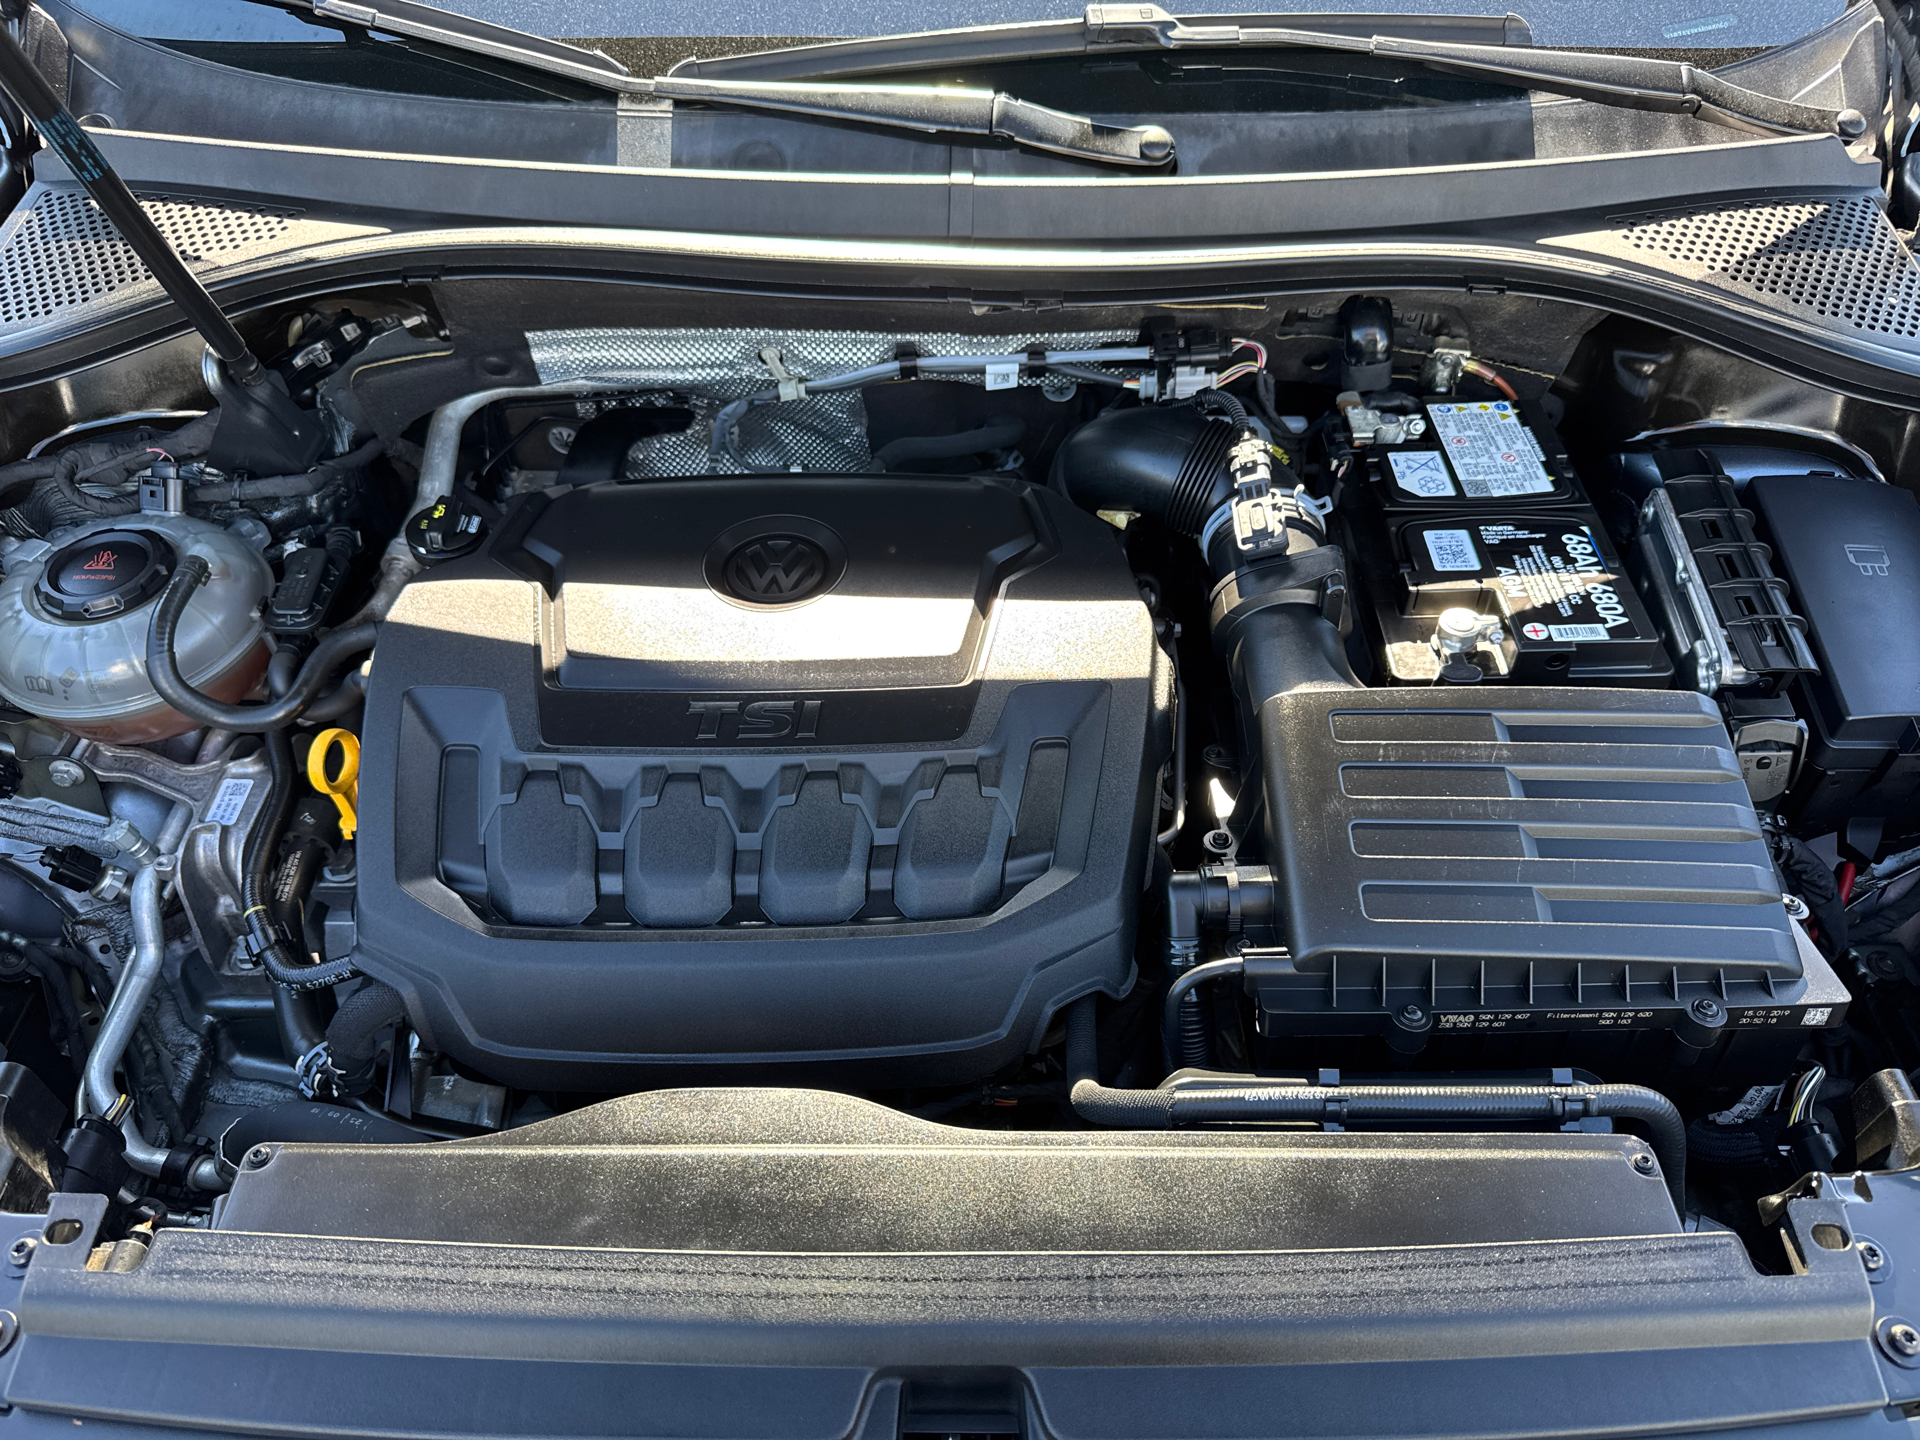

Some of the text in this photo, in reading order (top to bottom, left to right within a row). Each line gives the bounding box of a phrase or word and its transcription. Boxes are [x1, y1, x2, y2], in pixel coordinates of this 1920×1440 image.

[1396, 471, 1406, 480] Pb
[1496, 566, 1528, 597] AGM
[1550, 556, 1565, 568] 000
[1568, 594, 1583, 605] CC
[1561, 533, 1629, 628] 68Ah 680A
[686, 700, 823, 739] TSI
[306, 970, 352, 990] 52706-H
[1440, 1014, 1475, 1023] VWAG
